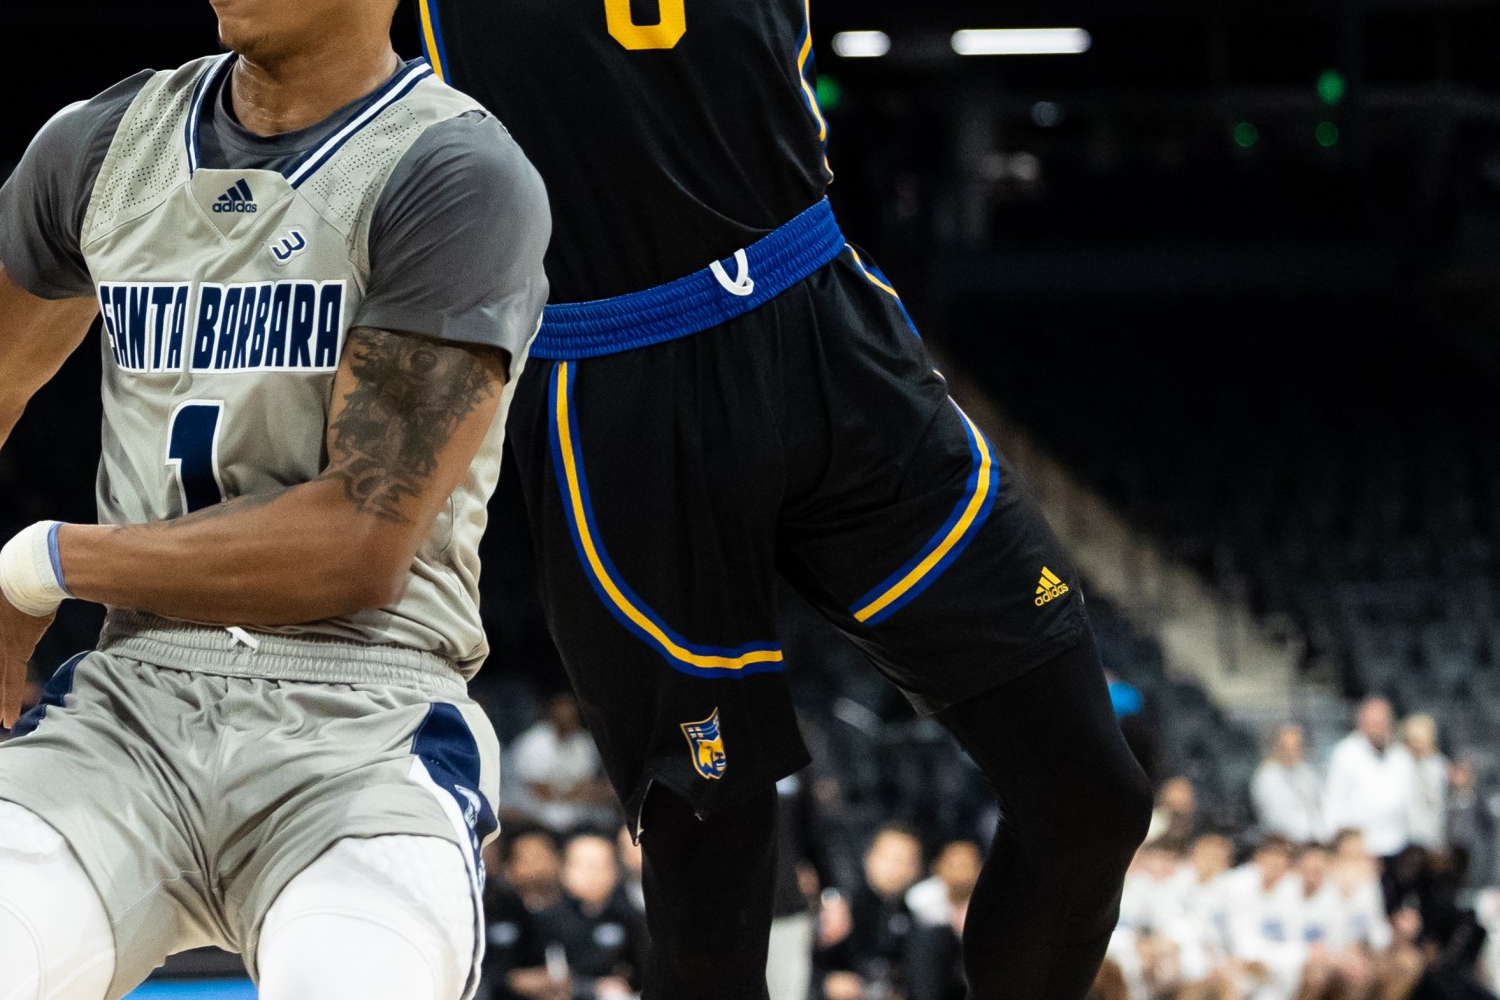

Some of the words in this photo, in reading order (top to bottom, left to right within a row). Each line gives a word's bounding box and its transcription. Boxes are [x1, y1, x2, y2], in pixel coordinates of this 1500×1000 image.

[212, 200, 257, 213] adidas
[99, 282, 191, 372] SANTA
[190, 281, 346, 373] BARBARA
[165, 399, 226, 515] 1
[1034, 583, 1069, 607] adidas
